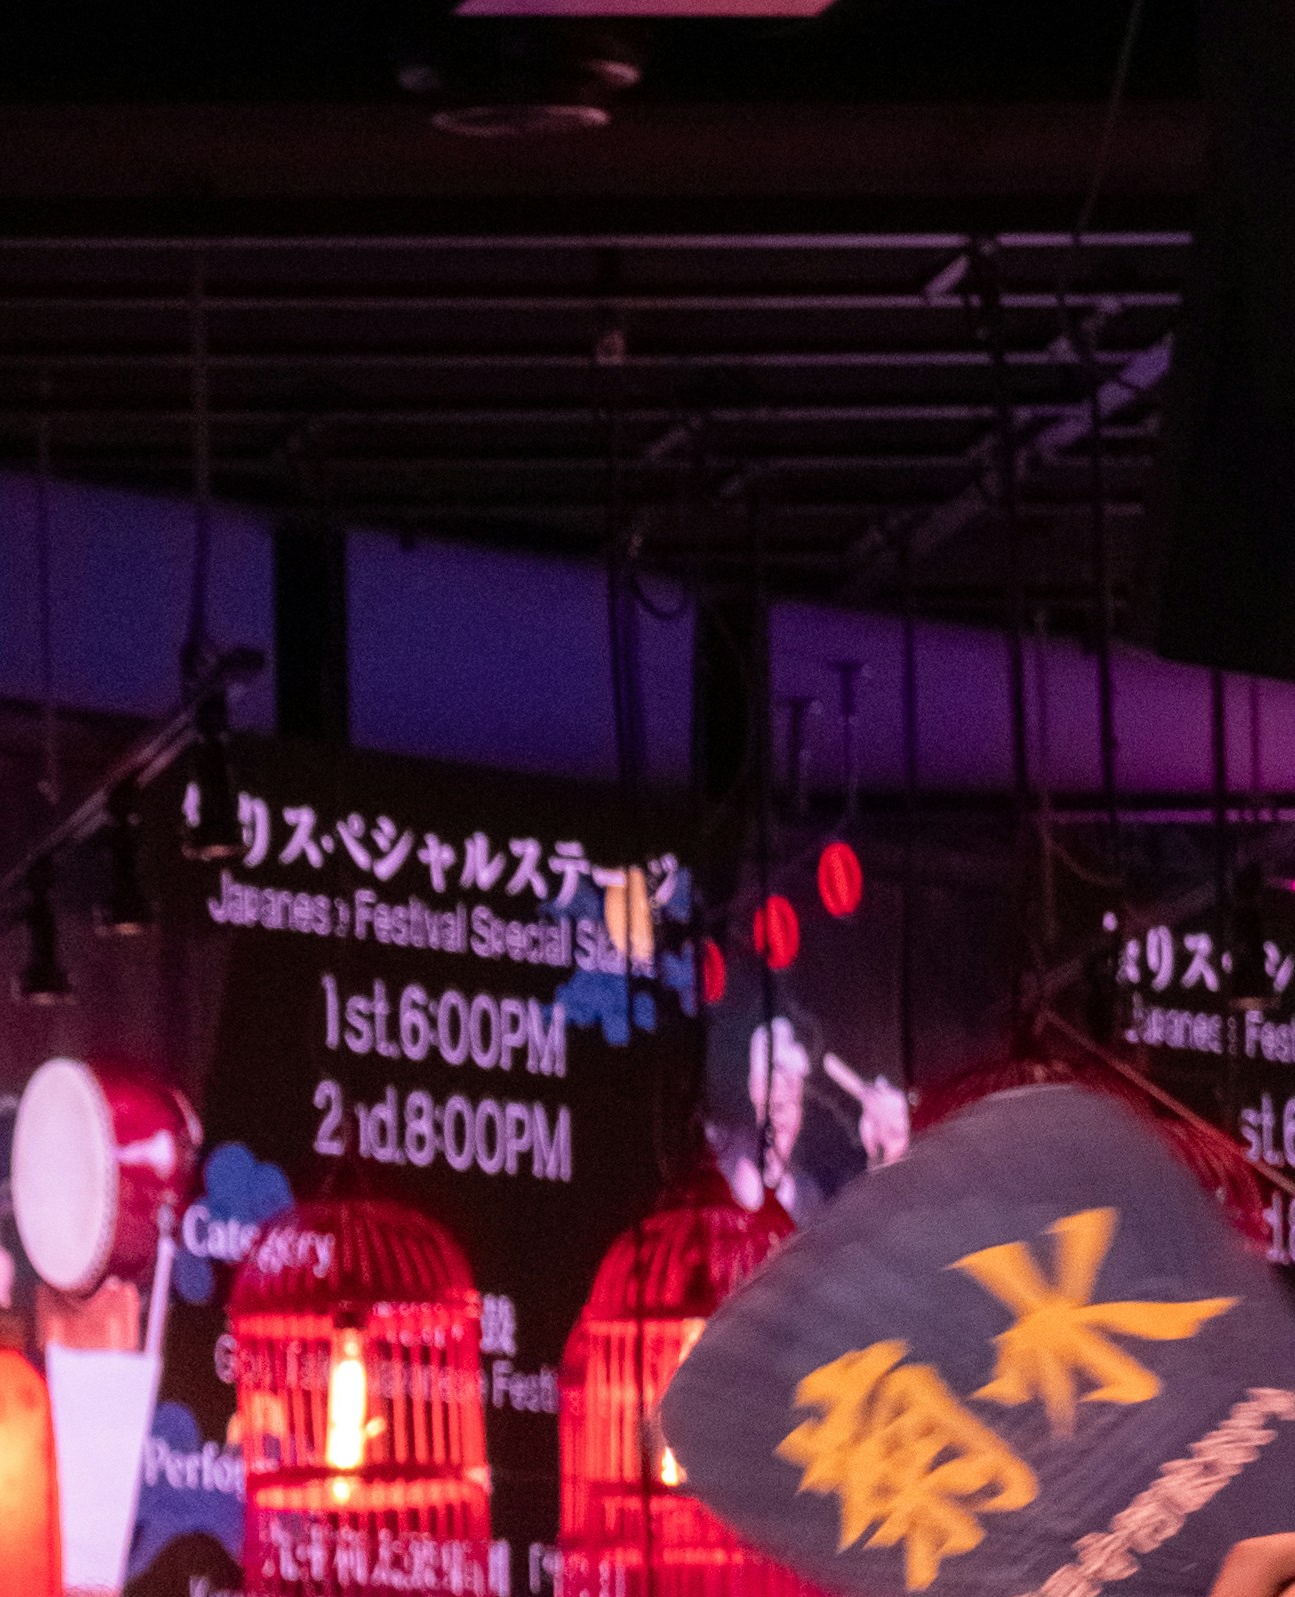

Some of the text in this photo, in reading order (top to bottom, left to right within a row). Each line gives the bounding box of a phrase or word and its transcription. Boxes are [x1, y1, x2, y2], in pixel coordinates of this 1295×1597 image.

[355, 889, 469, 954] Festival
[471, 904, 572, 968] Special
[771, 1205, 1245, 1591] 菊水
